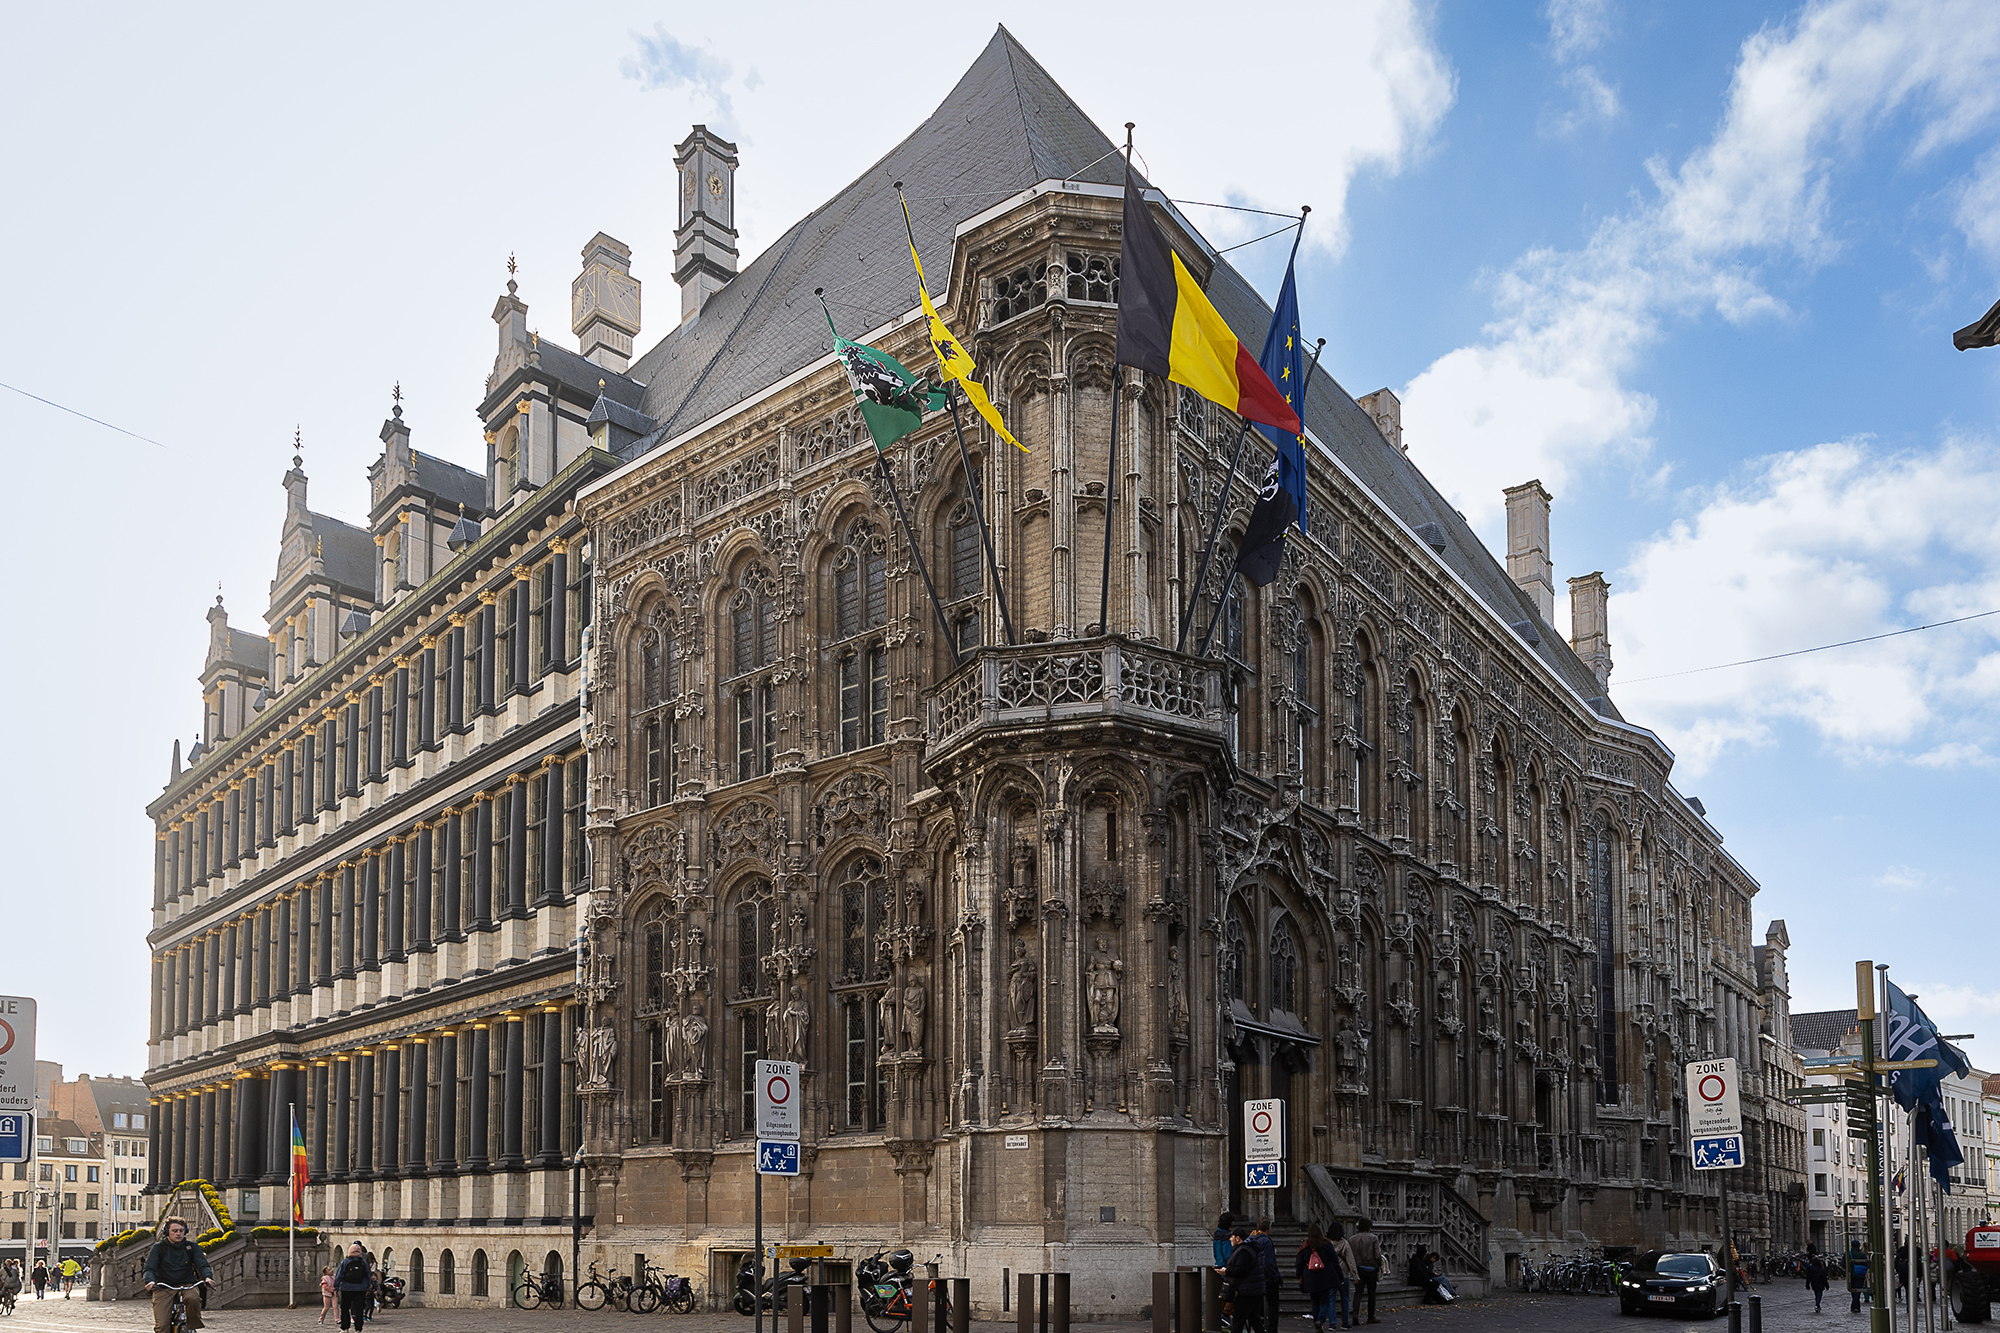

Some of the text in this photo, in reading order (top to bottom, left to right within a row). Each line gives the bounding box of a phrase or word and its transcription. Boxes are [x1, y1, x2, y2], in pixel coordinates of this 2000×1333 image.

[766, 1063, 791, 1075] ZONE
[1696, 1062, 1725, 1075] ZONE
[1251, 1102, 1273, 1111] ZONE
[1699, 1117, 1730, 1126] Uitgezonderd
[1693, 1125, 1738, 1134] vergunninghouders
[789, 1247, 813, 1256] Novotel
